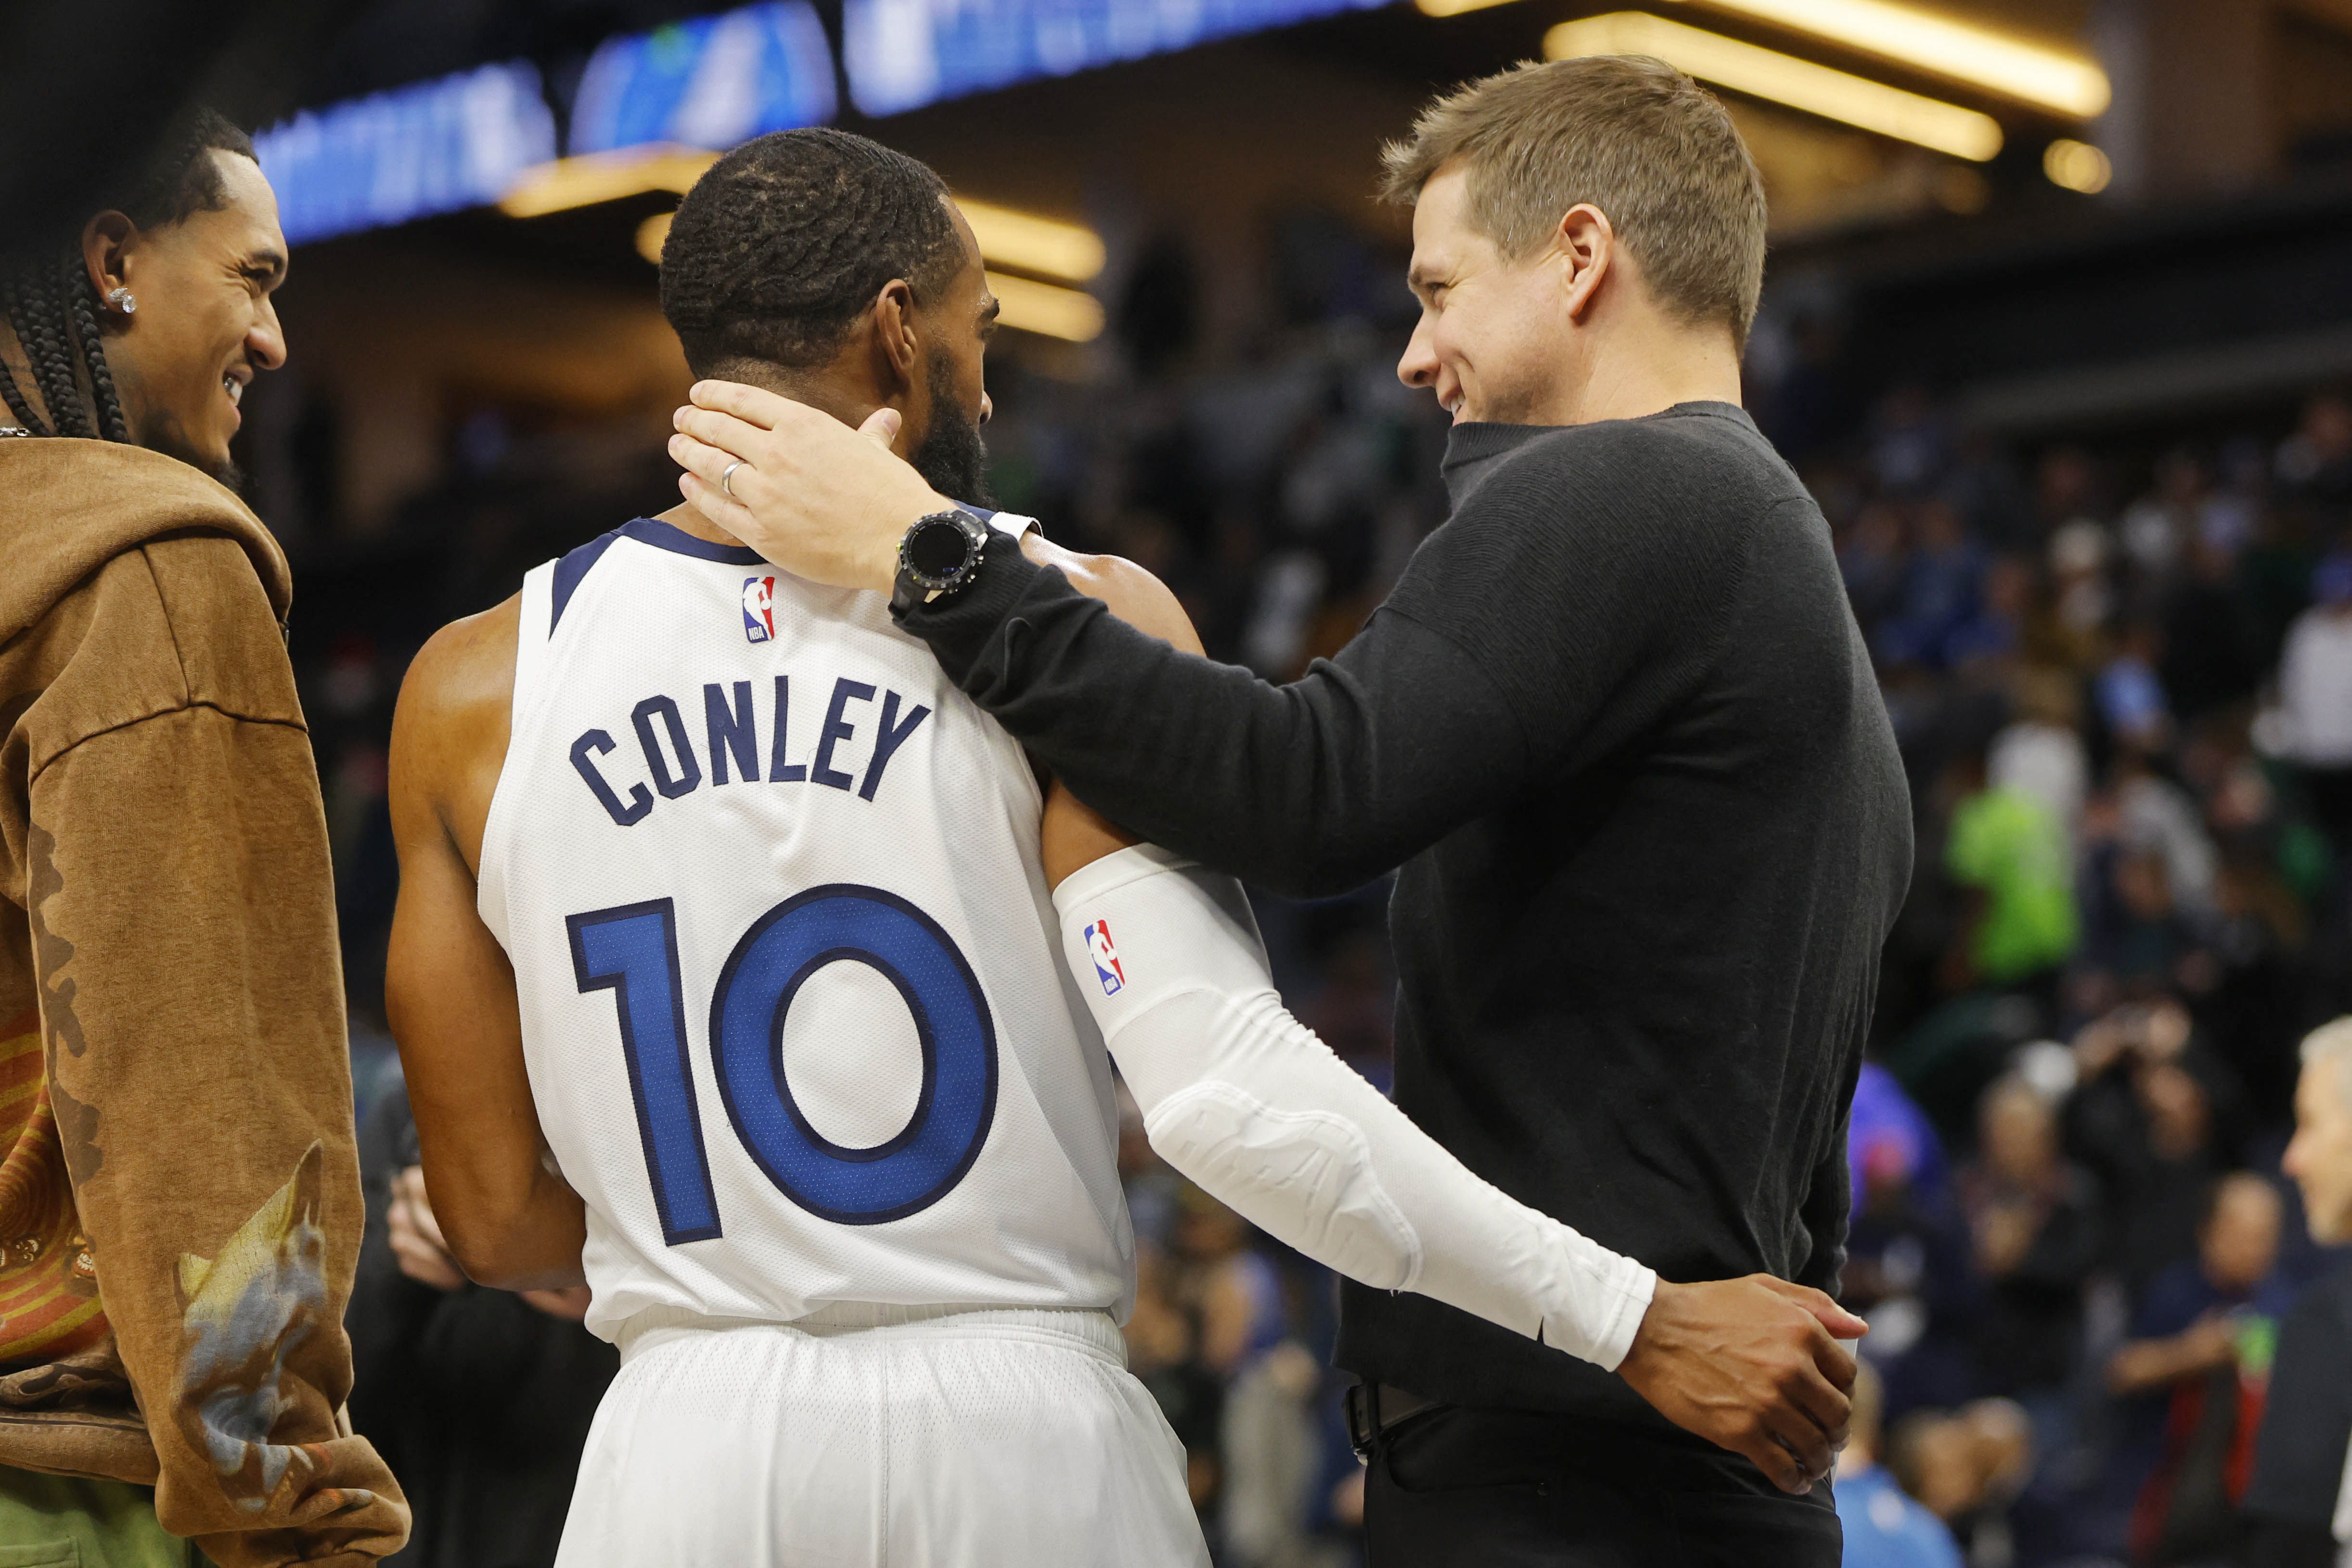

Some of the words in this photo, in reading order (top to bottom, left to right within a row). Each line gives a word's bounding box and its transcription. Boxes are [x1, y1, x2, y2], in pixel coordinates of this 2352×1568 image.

[748, 626, 764, 641] NBA
[569, 676, 931, 826] CONLEY
[1104, 976, 1118, 993] NBA
[565, 883, 999, 1247] 10
